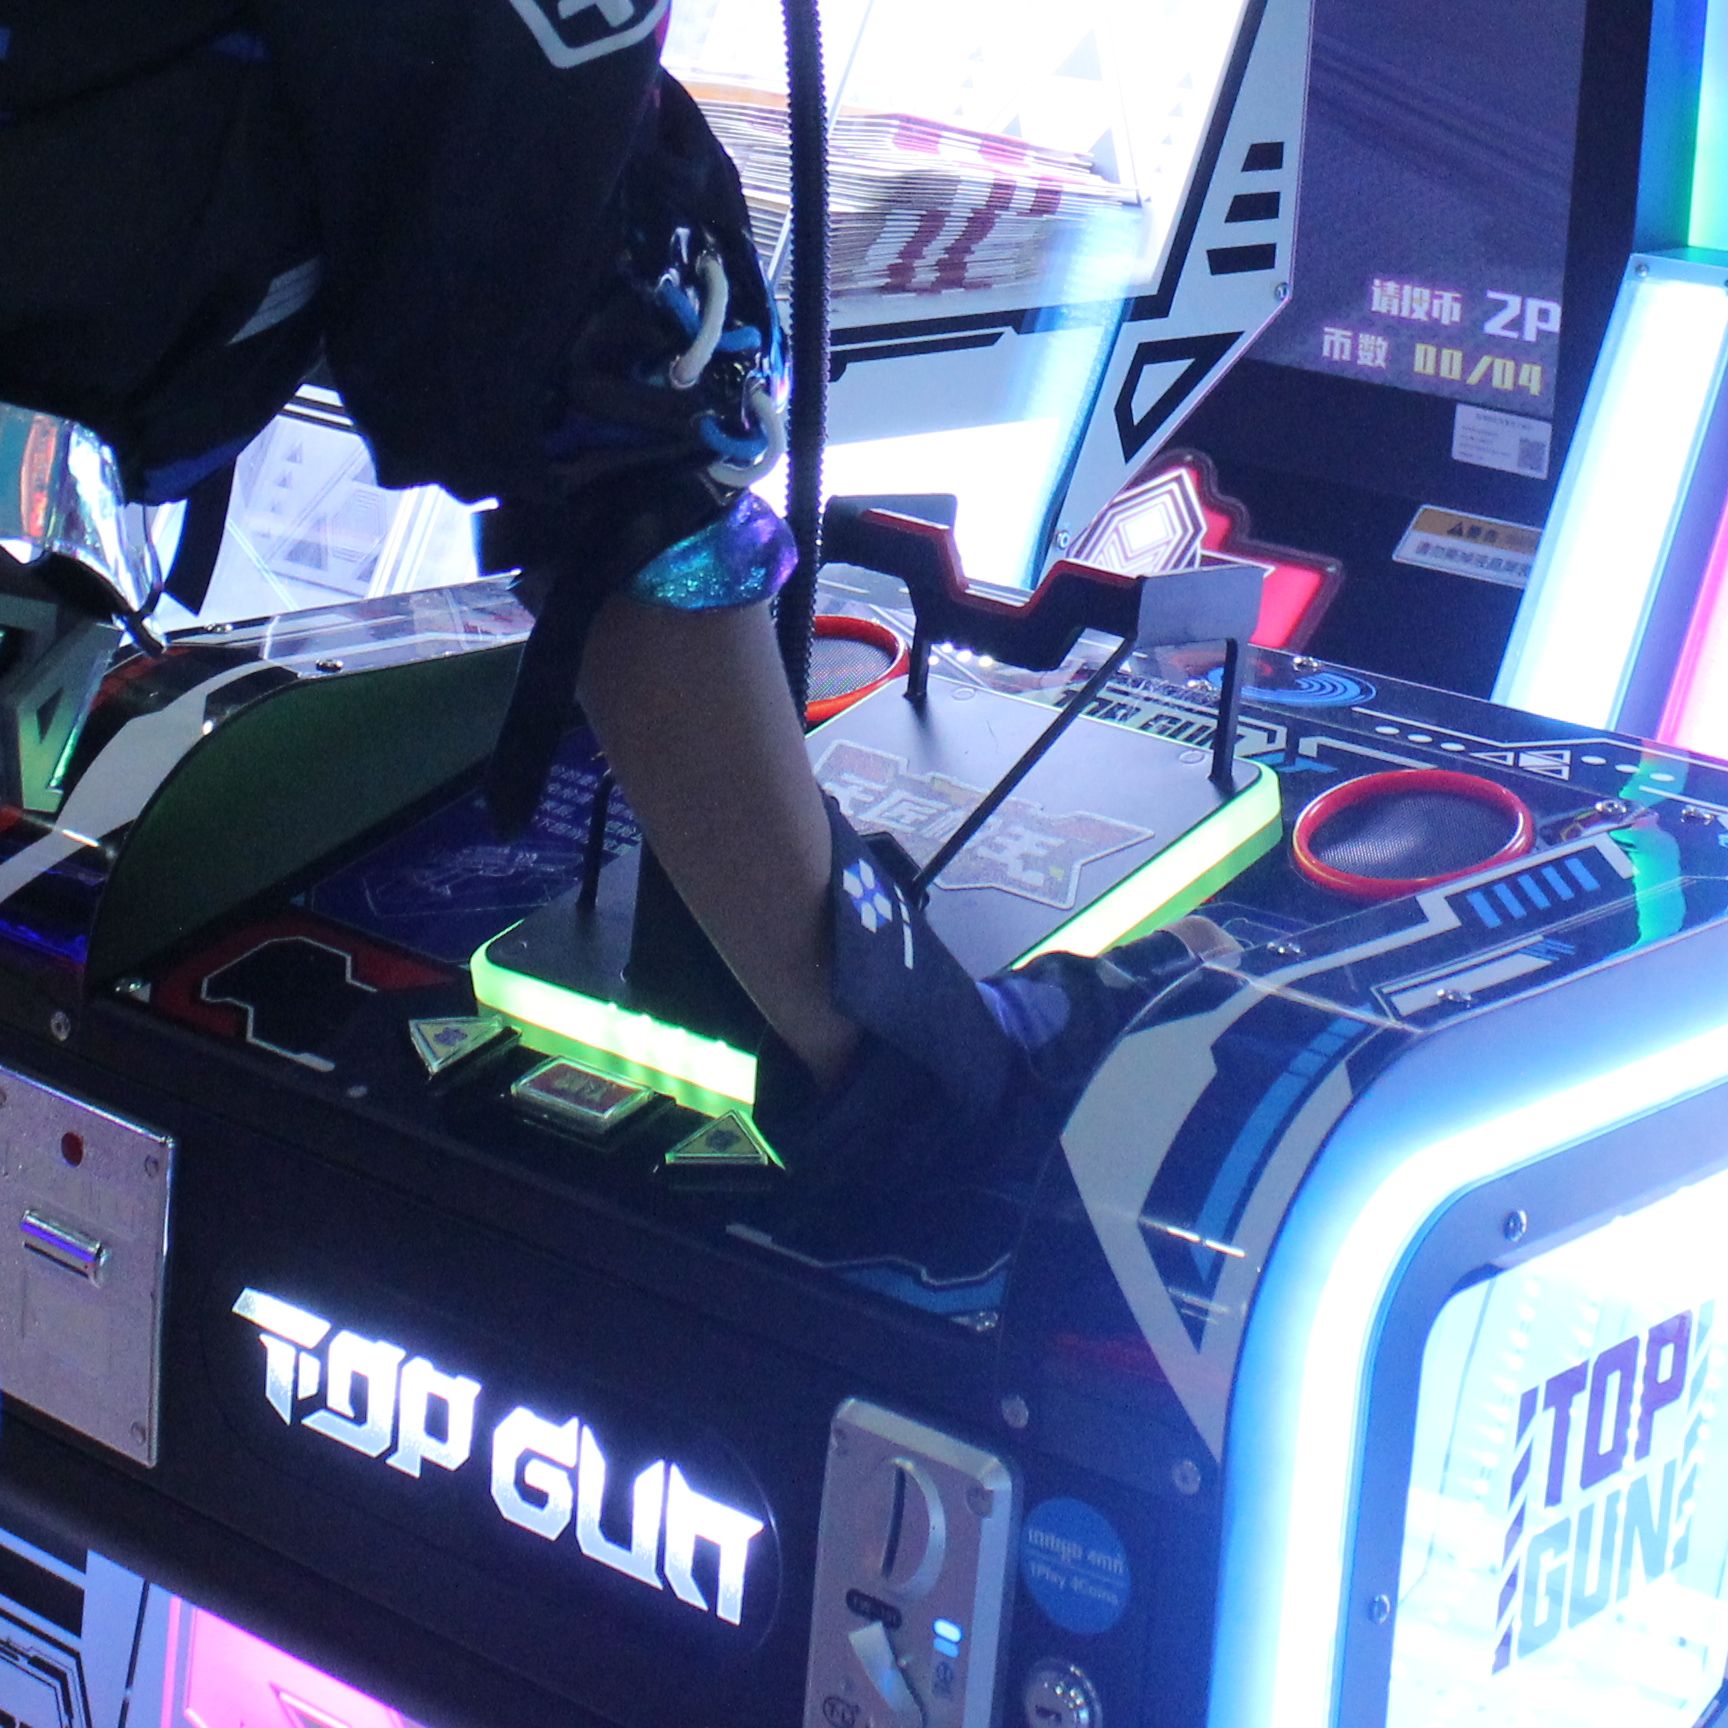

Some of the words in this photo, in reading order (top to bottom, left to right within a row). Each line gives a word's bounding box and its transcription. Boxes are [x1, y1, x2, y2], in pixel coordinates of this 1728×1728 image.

[1323, 328, 1389, 368] 币数
[1372, 279, 1462, 327] 请投币
[1482, 290, 1562, 342] 2P
[232, 1287, 480, 1478] TOP
[491, 1406, 765, 1626] GUN
[1541, 1309, 1693, 1510] TOP
[1517, 1457, 1677, 1660] GUN
